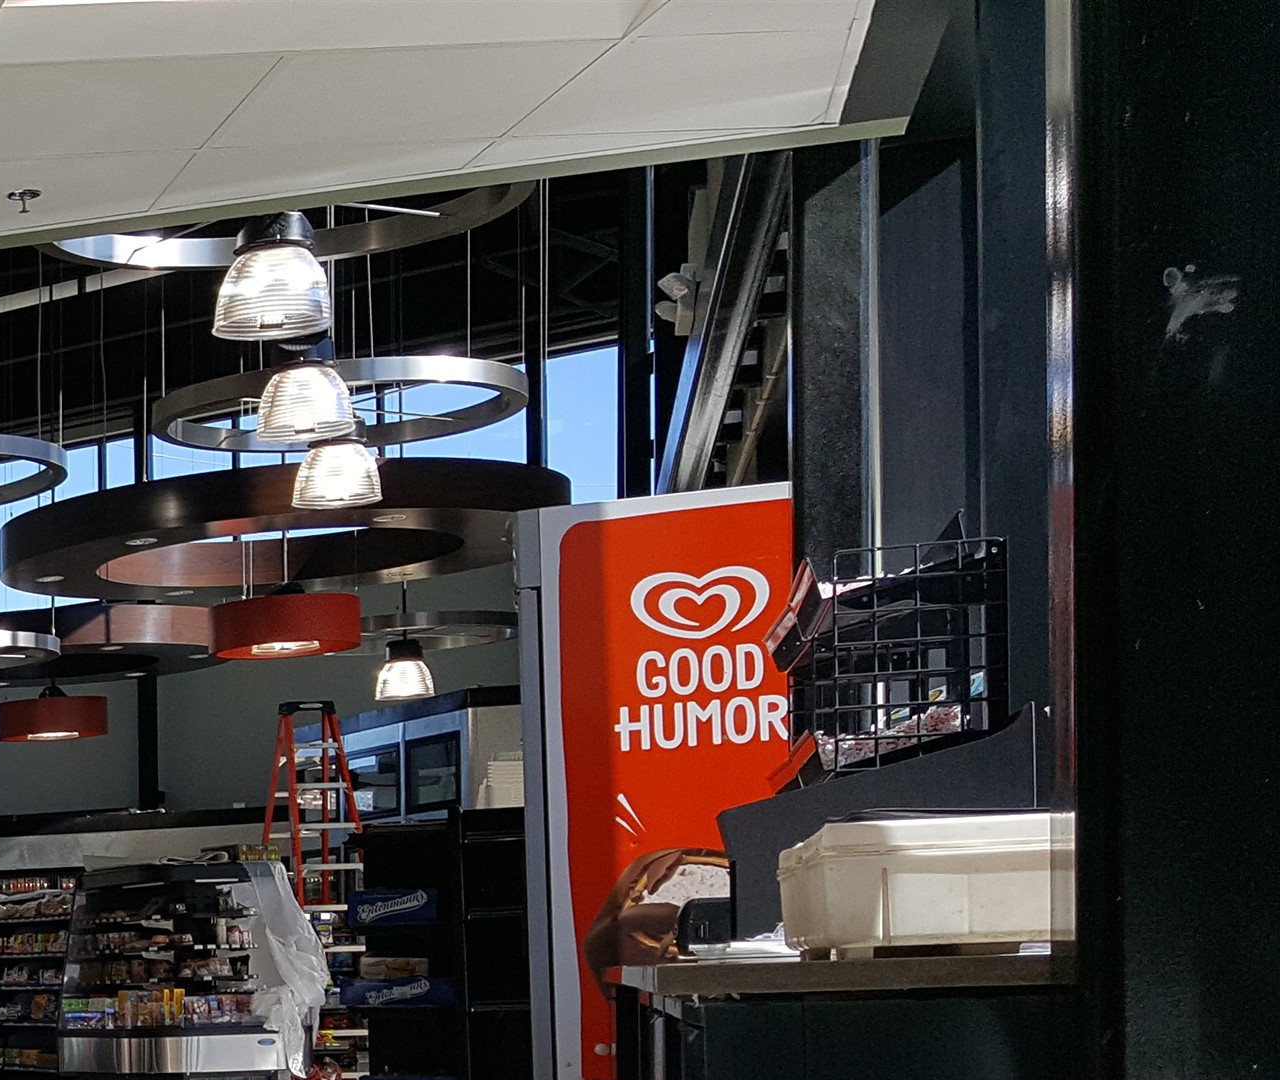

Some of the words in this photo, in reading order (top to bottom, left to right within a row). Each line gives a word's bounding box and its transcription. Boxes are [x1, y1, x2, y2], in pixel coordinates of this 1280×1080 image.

[636, 644, 764, 698] GOOD
[614, 694, 789, 752] HUMOR
[357, 890, 428, 923] Entenmann's
